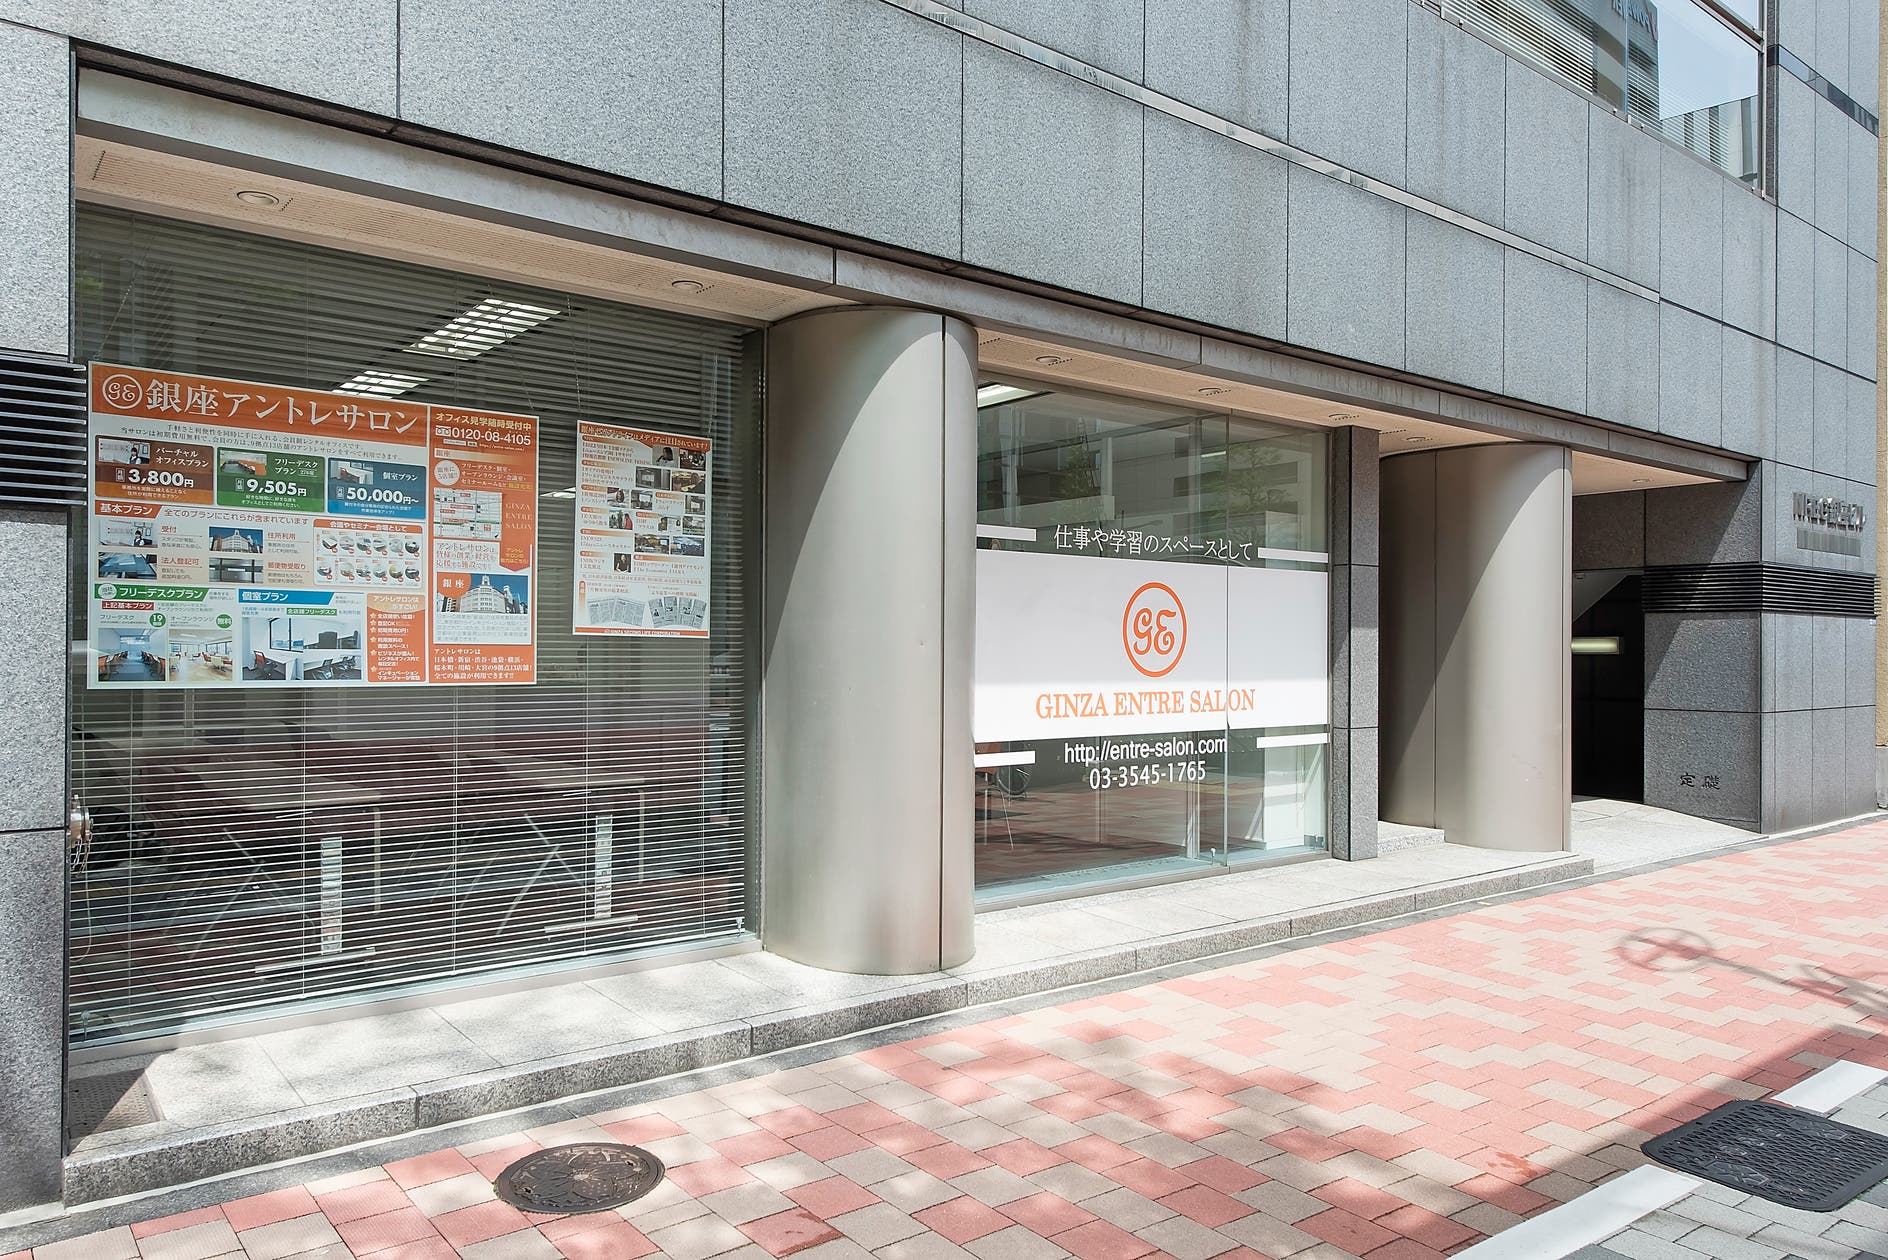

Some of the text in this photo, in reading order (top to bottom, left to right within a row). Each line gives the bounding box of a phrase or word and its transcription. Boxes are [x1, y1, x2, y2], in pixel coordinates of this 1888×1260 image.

[145, 378, 418, 434] 銀座アントレサロン
[436, 413, 531, 431] オフィス見学随時受付中
[452, 427, 531, 446] 0120-08-4105
[156, 447, 199, 458] バーチャル
[156, 457, 209, 467] オフィスプラン
[274, 458, 318, 469] フリーデスク
[128, 468, 194, 488] 3,800円
[274, 467, 297, 475] プラン
[382, 472, 418, 481] 個室プラン
[246, 479, 307, 497] 9,505円
[100, 503, 153, 515] 基本プラン
[165, 508, 309, 525] 全てのプランにこれらが含まれています
[1054, 524, 1253, 561] 仕事や学習のスペースとして
[120, 588, 203, 599] フリーデスクプラン
[242, 591, 289, 601] 個室プラン
[103, 601, 153, 610] 上記基本プラン
[152, 614, 162, 622] 19
[1036, 689, 1256, 719] GINZA ENTRE SALON
[1064, 736, 1227, 767] http://entre-salon.com
[1089, 760, 1206, 790] 03-3545-1765
